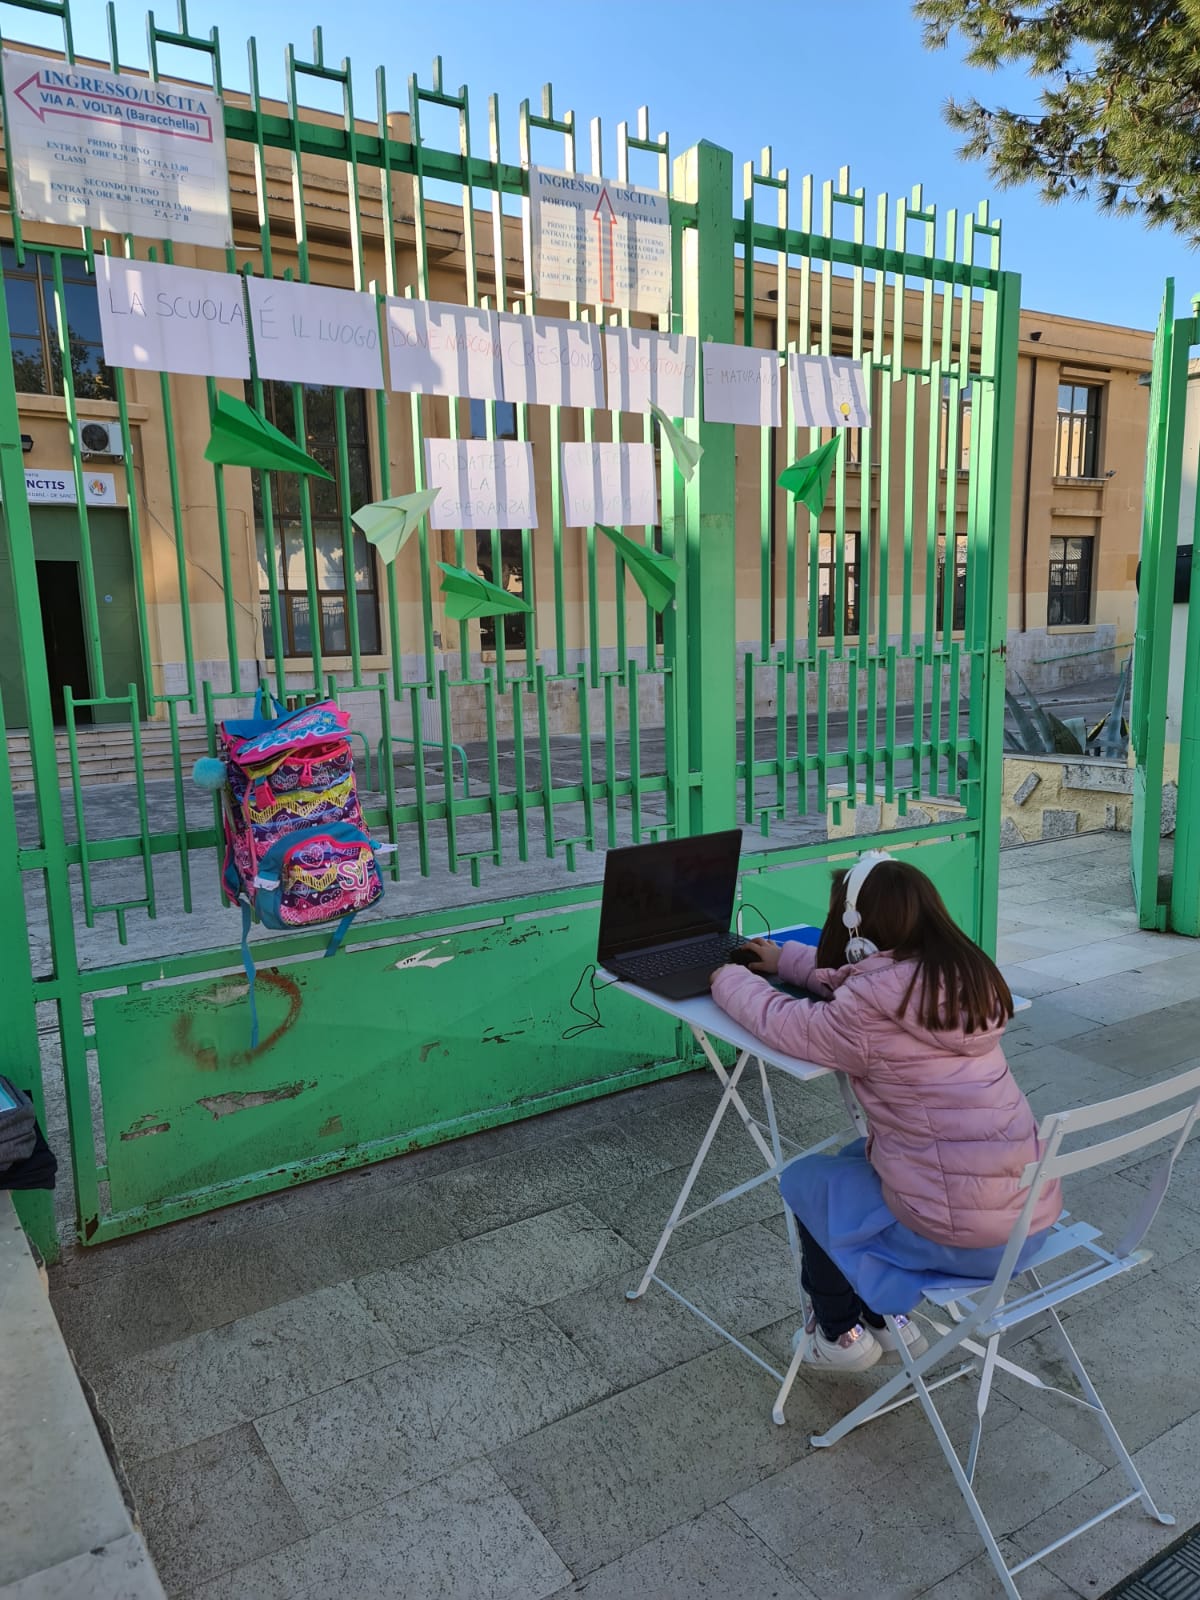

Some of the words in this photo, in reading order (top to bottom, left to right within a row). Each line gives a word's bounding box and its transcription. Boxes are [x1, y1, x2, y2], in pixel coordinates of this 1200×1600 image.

[44, 70, 208, 114] INGRESSO/USCITA
[40, 92, 63, 104] VIA
[66, 97, 79, 108] A.
[82, 99, 123, 117] VOLTA
[126, 107, 200, 134] (Baracchella)
[46, 140, 90, 156] ENTRATA
[87, 137, 117, 150] PRIMO
[120, 143, 150, 155] TURNO
[54, 152, 87, 165] CLASSI
[50, 182, 94, 197] ENTRATA
[140, 196, 172, 210] USCITA
[84, 177, 127, 192] SECONDO
[129, 184, 160, 197] TURNO
[538, 172, 600, 196] INGRESSO
[616, 188, 657, 208] USCITA
[109, 288, 147, 317] LA
[156, 292, 244, 327] SCUOLA
[292, 313, 310, 338] IL
[319, 319, 377, 350] LUOGO
[391, 326, 441, 350] DOVE
[508, 340, 602, 372] CRESCONO
[704, 367, 714, 385] E
[26, 479, 65, 490] NCTIS
[470, 476, 490, 491] LA
[337, 859, 369, 890] SJ
